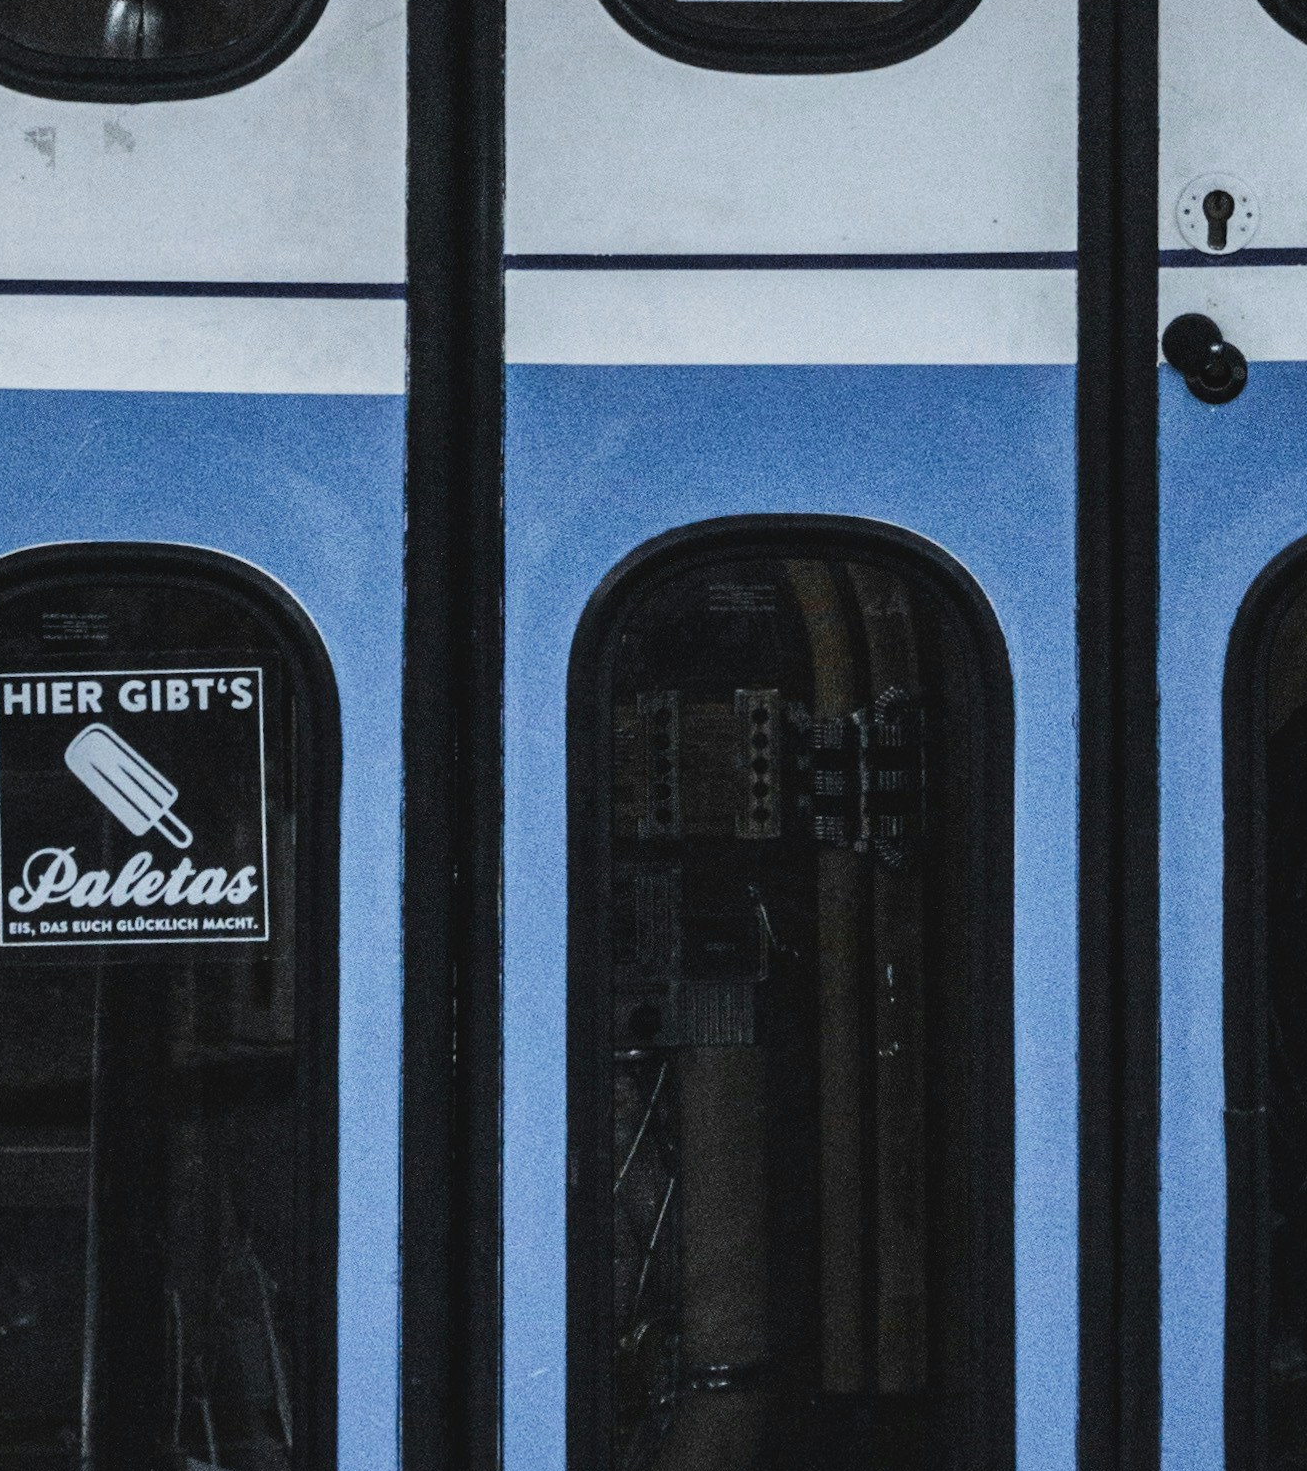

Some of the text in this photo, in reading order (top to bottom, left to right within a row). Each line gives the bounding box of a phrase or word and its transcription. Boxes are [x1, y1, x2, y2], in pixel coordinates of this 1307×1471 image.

[3, 680, 104, 716] HIER
[8, 846, 259, 914] Paletas
[8, 915, 259, 937] EIS, DAS EUCH GLÜCKLICH MACHT.
